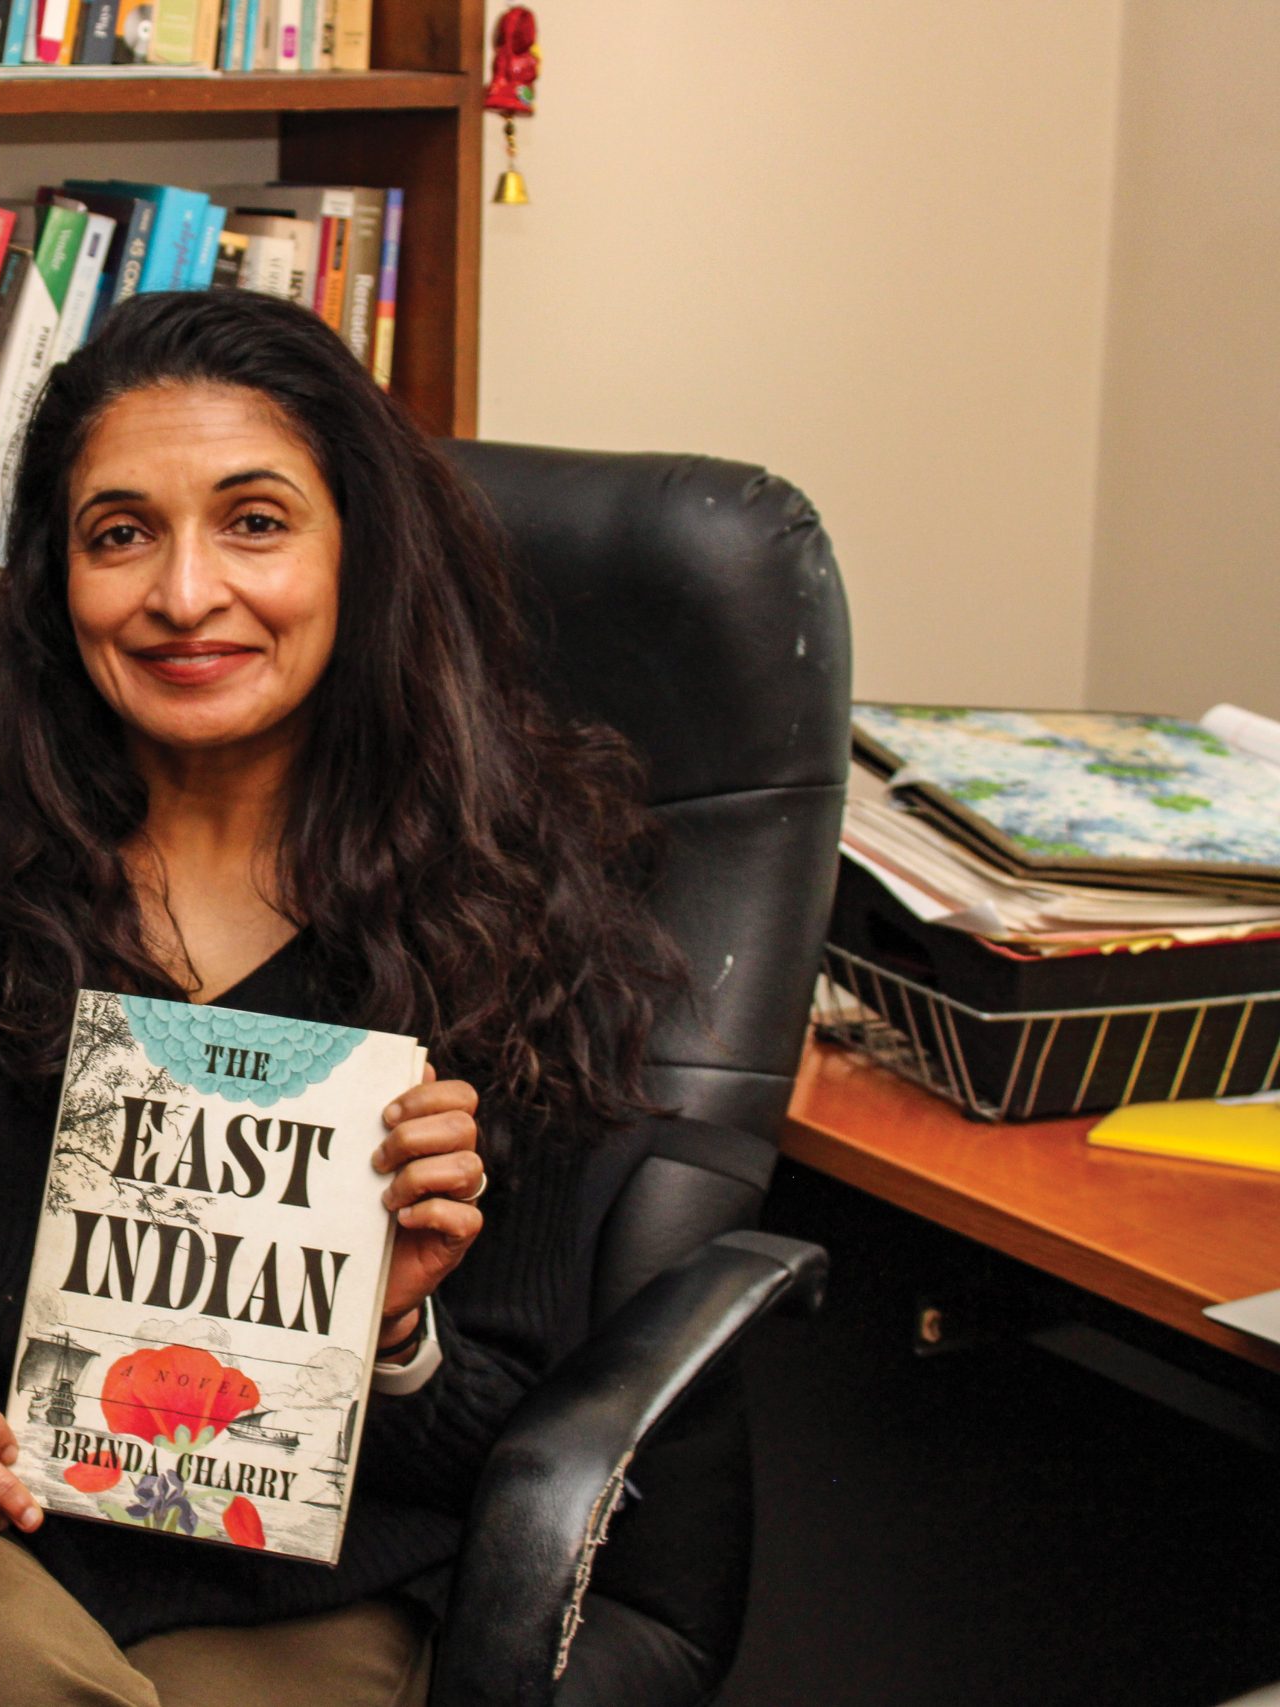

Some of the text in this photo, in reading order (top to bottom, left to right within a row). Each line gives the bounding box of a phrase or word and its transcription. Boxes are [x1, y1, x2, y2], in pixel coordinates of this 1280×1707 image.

[51, 229, 72, 271] Vendler
[204, 1044, 272, 1082] THE
[111, 1095, 336, 1208] EAST
[60, 1209, 350, 1336] INDIAN
[120, 1365, 251, 1399] A NOVEL
[51, 1430, 298, 1502] BRINDA CHARRY
